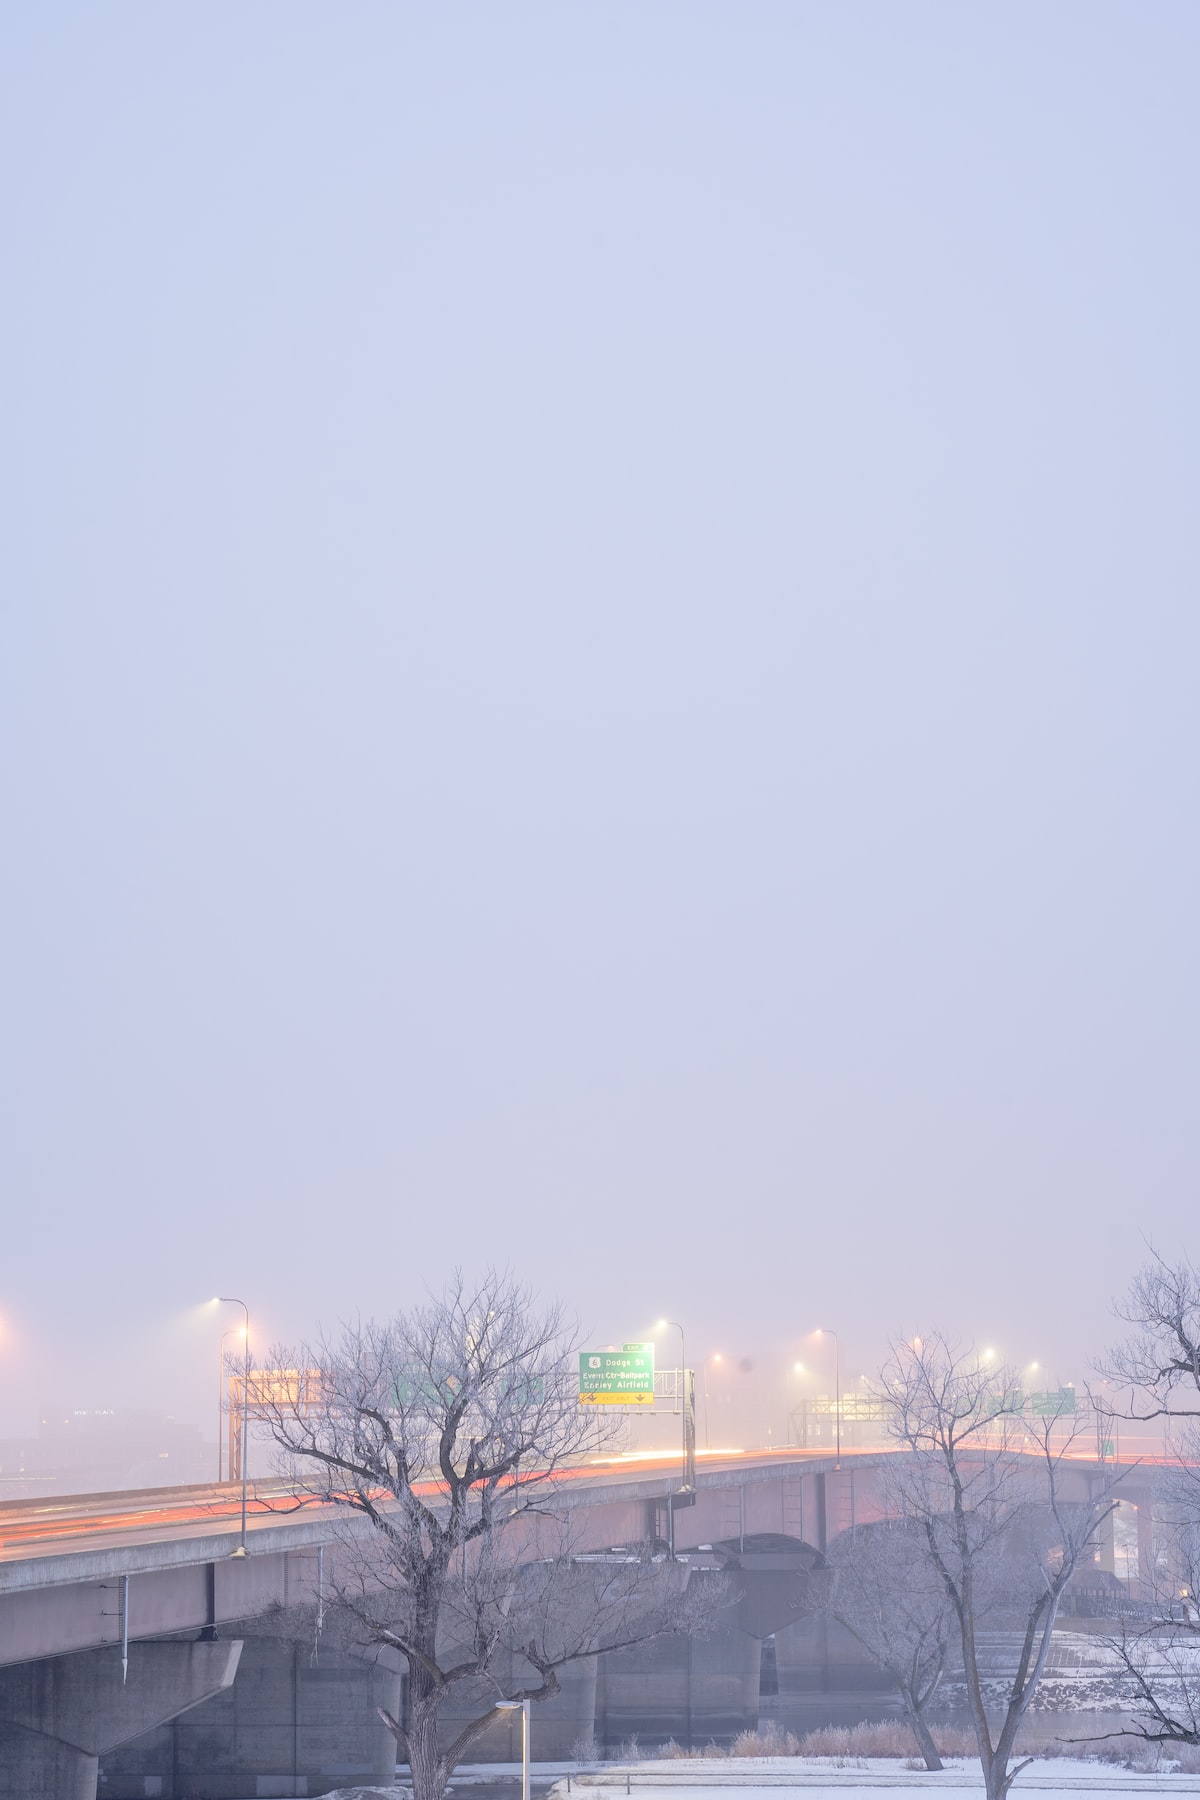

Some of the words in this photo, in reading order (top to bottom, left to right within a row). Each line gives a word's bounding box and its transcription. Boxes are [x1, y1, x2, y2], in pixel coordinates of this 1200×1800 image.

[605, 1359, 631, 1368] Dodge
[635, 1358, 645, 1366] St
[605, 1371, 650, 1380] Ctr-Ballpark
[617, 1381, 649, 1389] Airfield
